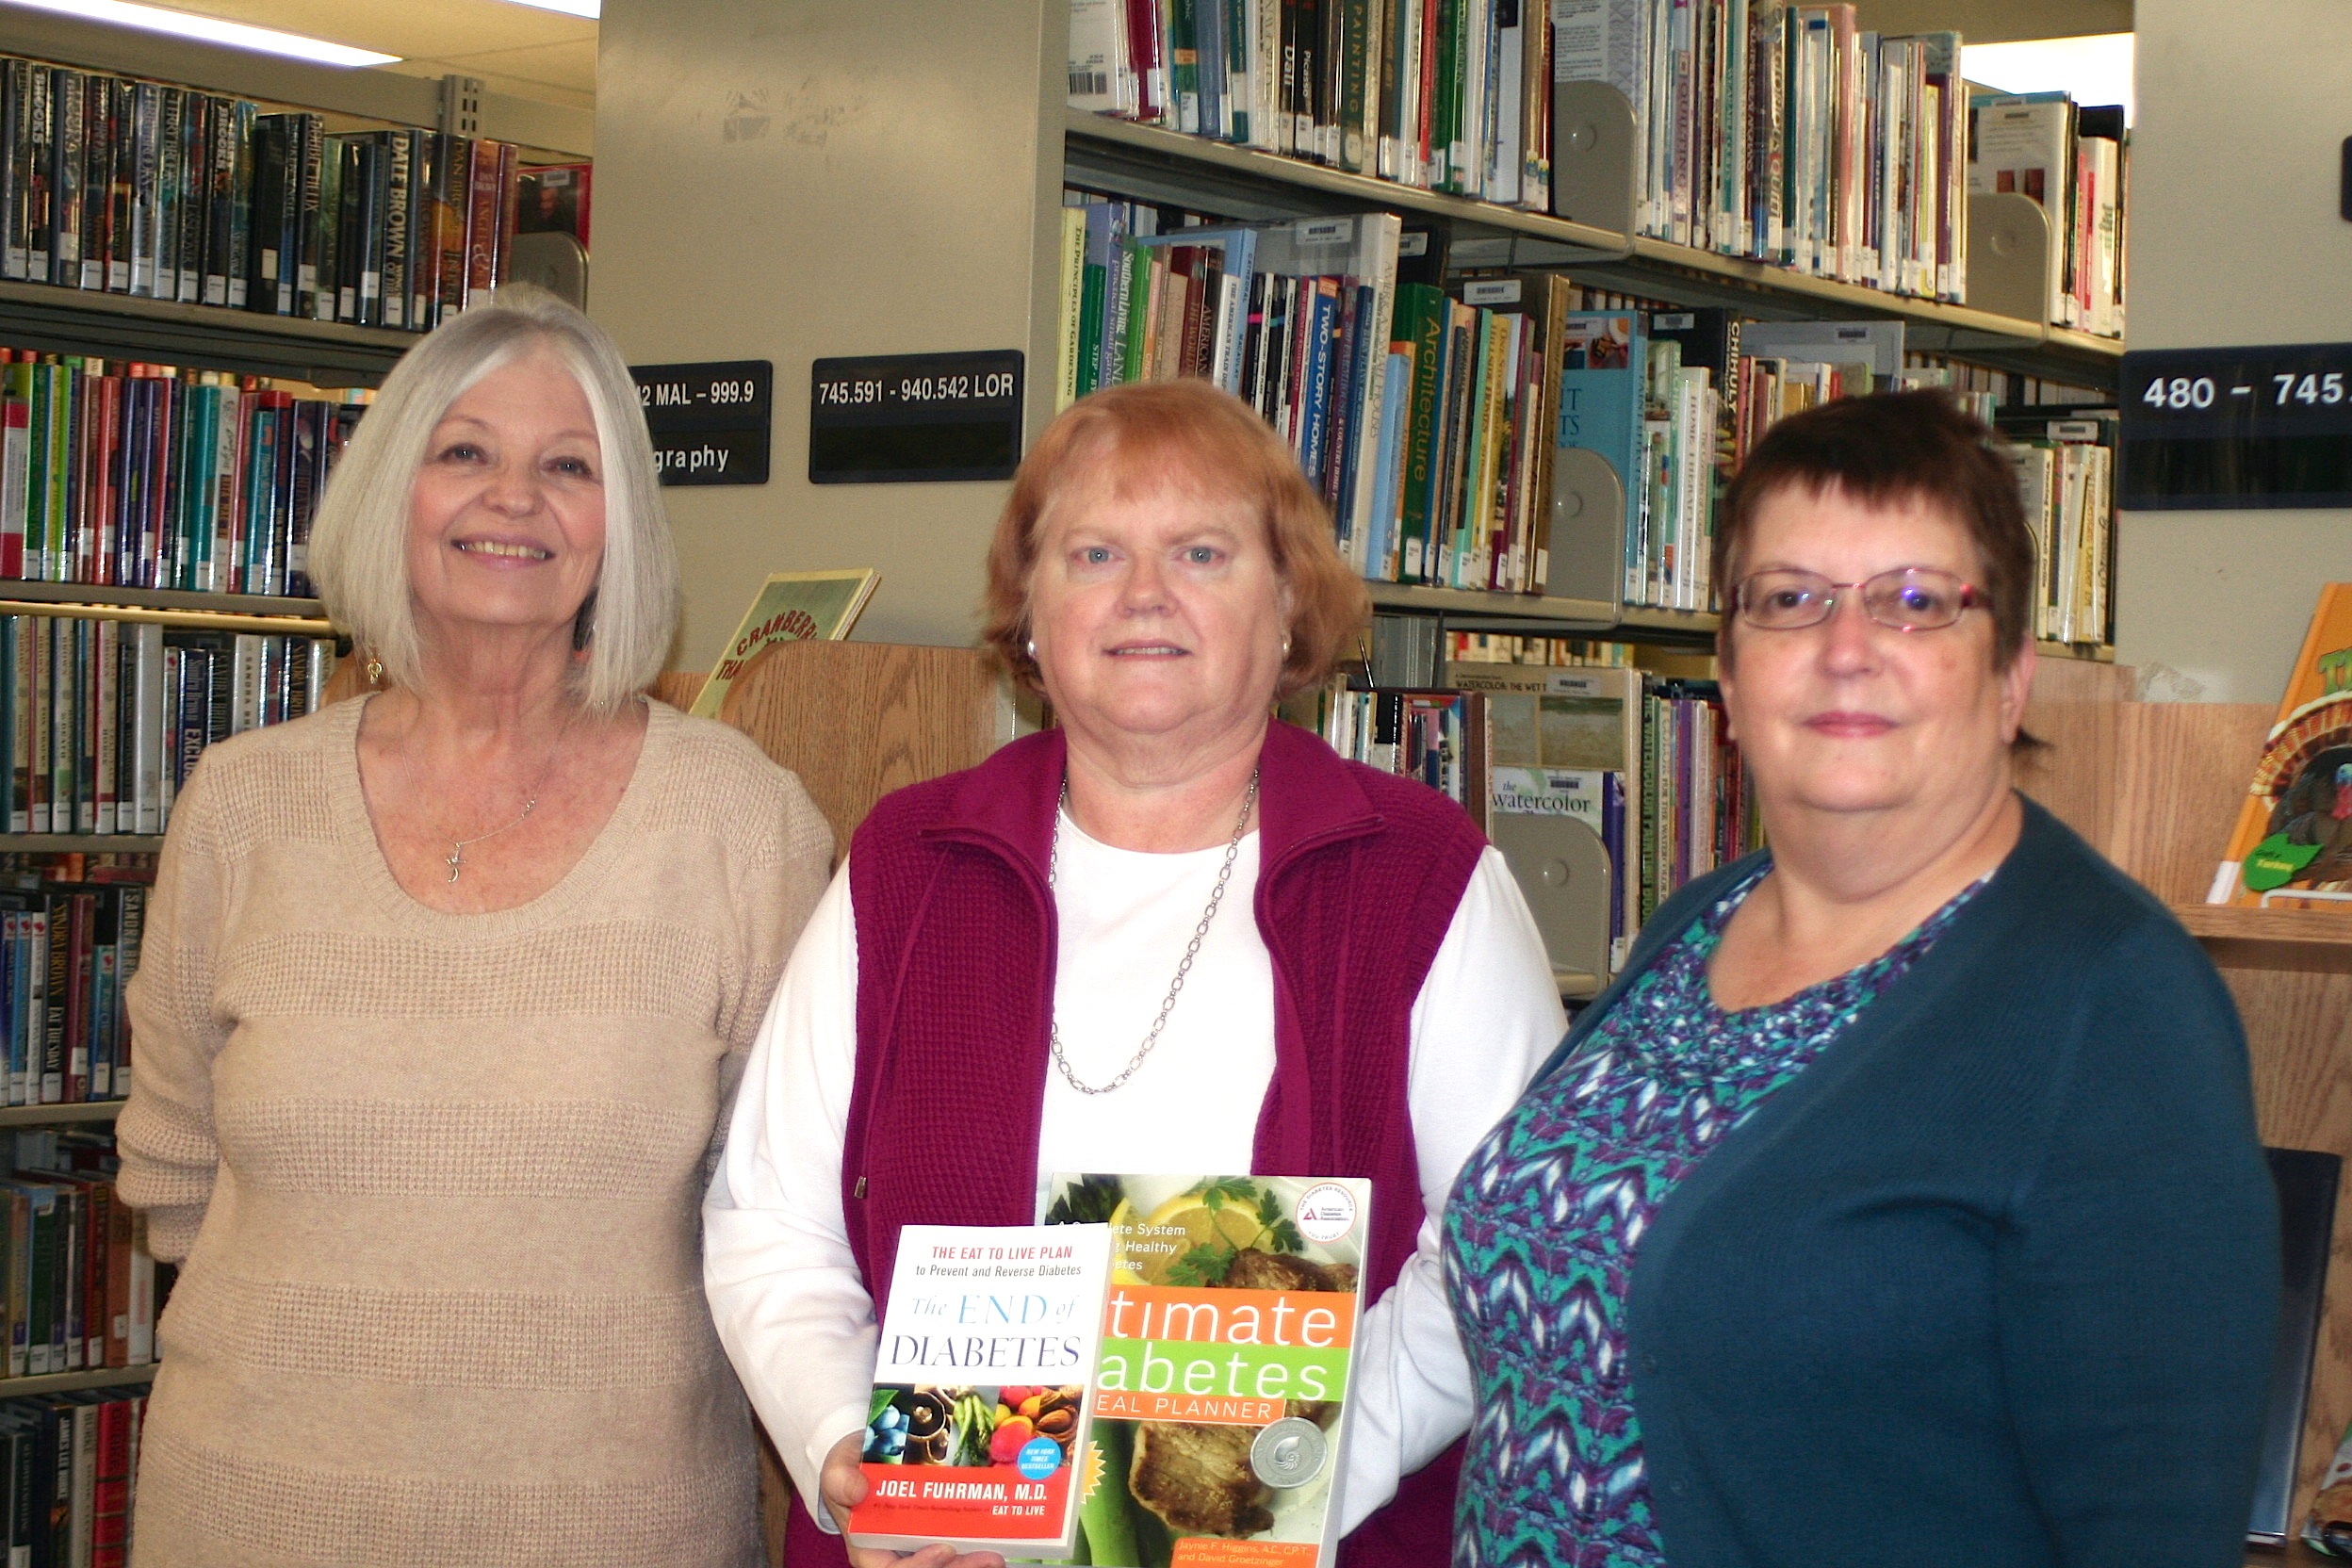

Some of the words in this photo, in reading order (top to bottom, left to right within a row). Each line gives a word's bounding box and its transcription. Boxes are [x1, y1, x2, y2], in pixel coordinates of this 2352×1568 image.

[1302, 50, 1312, 97] Picasso
[1350, 4, 1364, 113] PAINTING
[390, 136, 410, 183] DALE
[386, 188, 409, 258] BROWN
[1075, 226, 1084, 250] THE
[1071, 251, 1084, 315] PRINCIPLES
[1110, 259, 1122, 296] practical
[1119, 251, 1135, 302] Southern
[1243, 252, 1253, 302] CATHEDRAL
[1070, 318, 1077, 330] OF
[1107, 298, 1118, 331] small
[1116, 302, 1132, 335] Living
[1226, 301, 1236, 344] AMERICAN
[1198, 304, 1214, 374] AMERICAN
[1067, 332, 1076, 397] GARDENING
[1092, 343, 1101, 369] STEP
[1102, 332, 1115, 388] garde
[1224, 346, 1233, 371] TRAIN
[1234, 334, 1245, 380] MACAULAY
[1315, 303, 1332, 410] TWO-STORY
[1728, 321, 1741, 414] CHIHULY
[656, 383, 692, 406] MAL
[710, 380, 755, 404] 999.9
[819, 380, 884, 405] 745.591
[902, 375, 969, 402] 940.542
[973, 372, 1015, 398] LOR
[1338, 342, 1353, 416] FARMHOUSE
[2143, 377, 2215, 409] 480
[1413, 317, 1442, 483] Architecture
[653, 444, 729, 473] graphy
[1307, 413, 1321, 479] HOMES
[1510, 681, 1523, 692] THE
[1526, 682, 1541, 692] WET
[183, 728, 204, 781] EXCLUS
[1493, 790, 1592, 814] watercolor
[1502, 780, 1517, 792] the
[52, 902, 69, 950] SANDRA
[49, 950, 66, 996] BROWN
[46, 1025, 63, 1070] TUESDAY
[1137, 1223, 1186, 1239] System
[932, 1246, 956, 1260] THE
[960, 1247, 984, 1260] EAT
[989, 1247, 1004, 1260] TO
[1008, 1247, 1036, 1260] LIVE
[1040, 1246, 1073, 1260] PLAN
[1125, 1241, 1177, 1255] Healthy
[916, 1265, 926, 1276] to
[929, 1264, 969, 1277] Prevent
[972, 1266, 990, 1277] and
[994, 1266, 1035, 1277] Reverse
[1038, 1264, 1082, 1277] Diabetes
[912, 1296, 948, 1315] The
[958, 1294, 1048, 1324] END
[1055, 1295, 1081, 1324] of
[1110, 1290, 1337, 1348] timate
[890, 1334, 1082, 1367] DIABETES
[1097, 1341, 1329, 1401] abetes
[1096, 1394, 1142, 1413] EAL
[1154, 1397, 1272, 1420] PLANNER
[58, 1416, 71, 1450] JAMES
[57, 1451, 70, 1469] LEE
[57, 1470, 69, 1500] BURKE
[875, 1479, 918, 1498] JOEL
[923, 1481, 1008, 1502] FUHRMAN,
[1014, 1483, 1048, 1501] M.D.
[992, 1504, 1008, 1516] EAT
[1011, 1504, 1024, 1516] TO
[1026, 1505, 1046, 1516] LIVE
[1178, 1553, 1196, 1561] and
[1198, 1552, 1226, 1563] David
[1179, 1541, 1208, 1551] Jaynie
[1222, 1544, 1259, 1554] Higgins,
